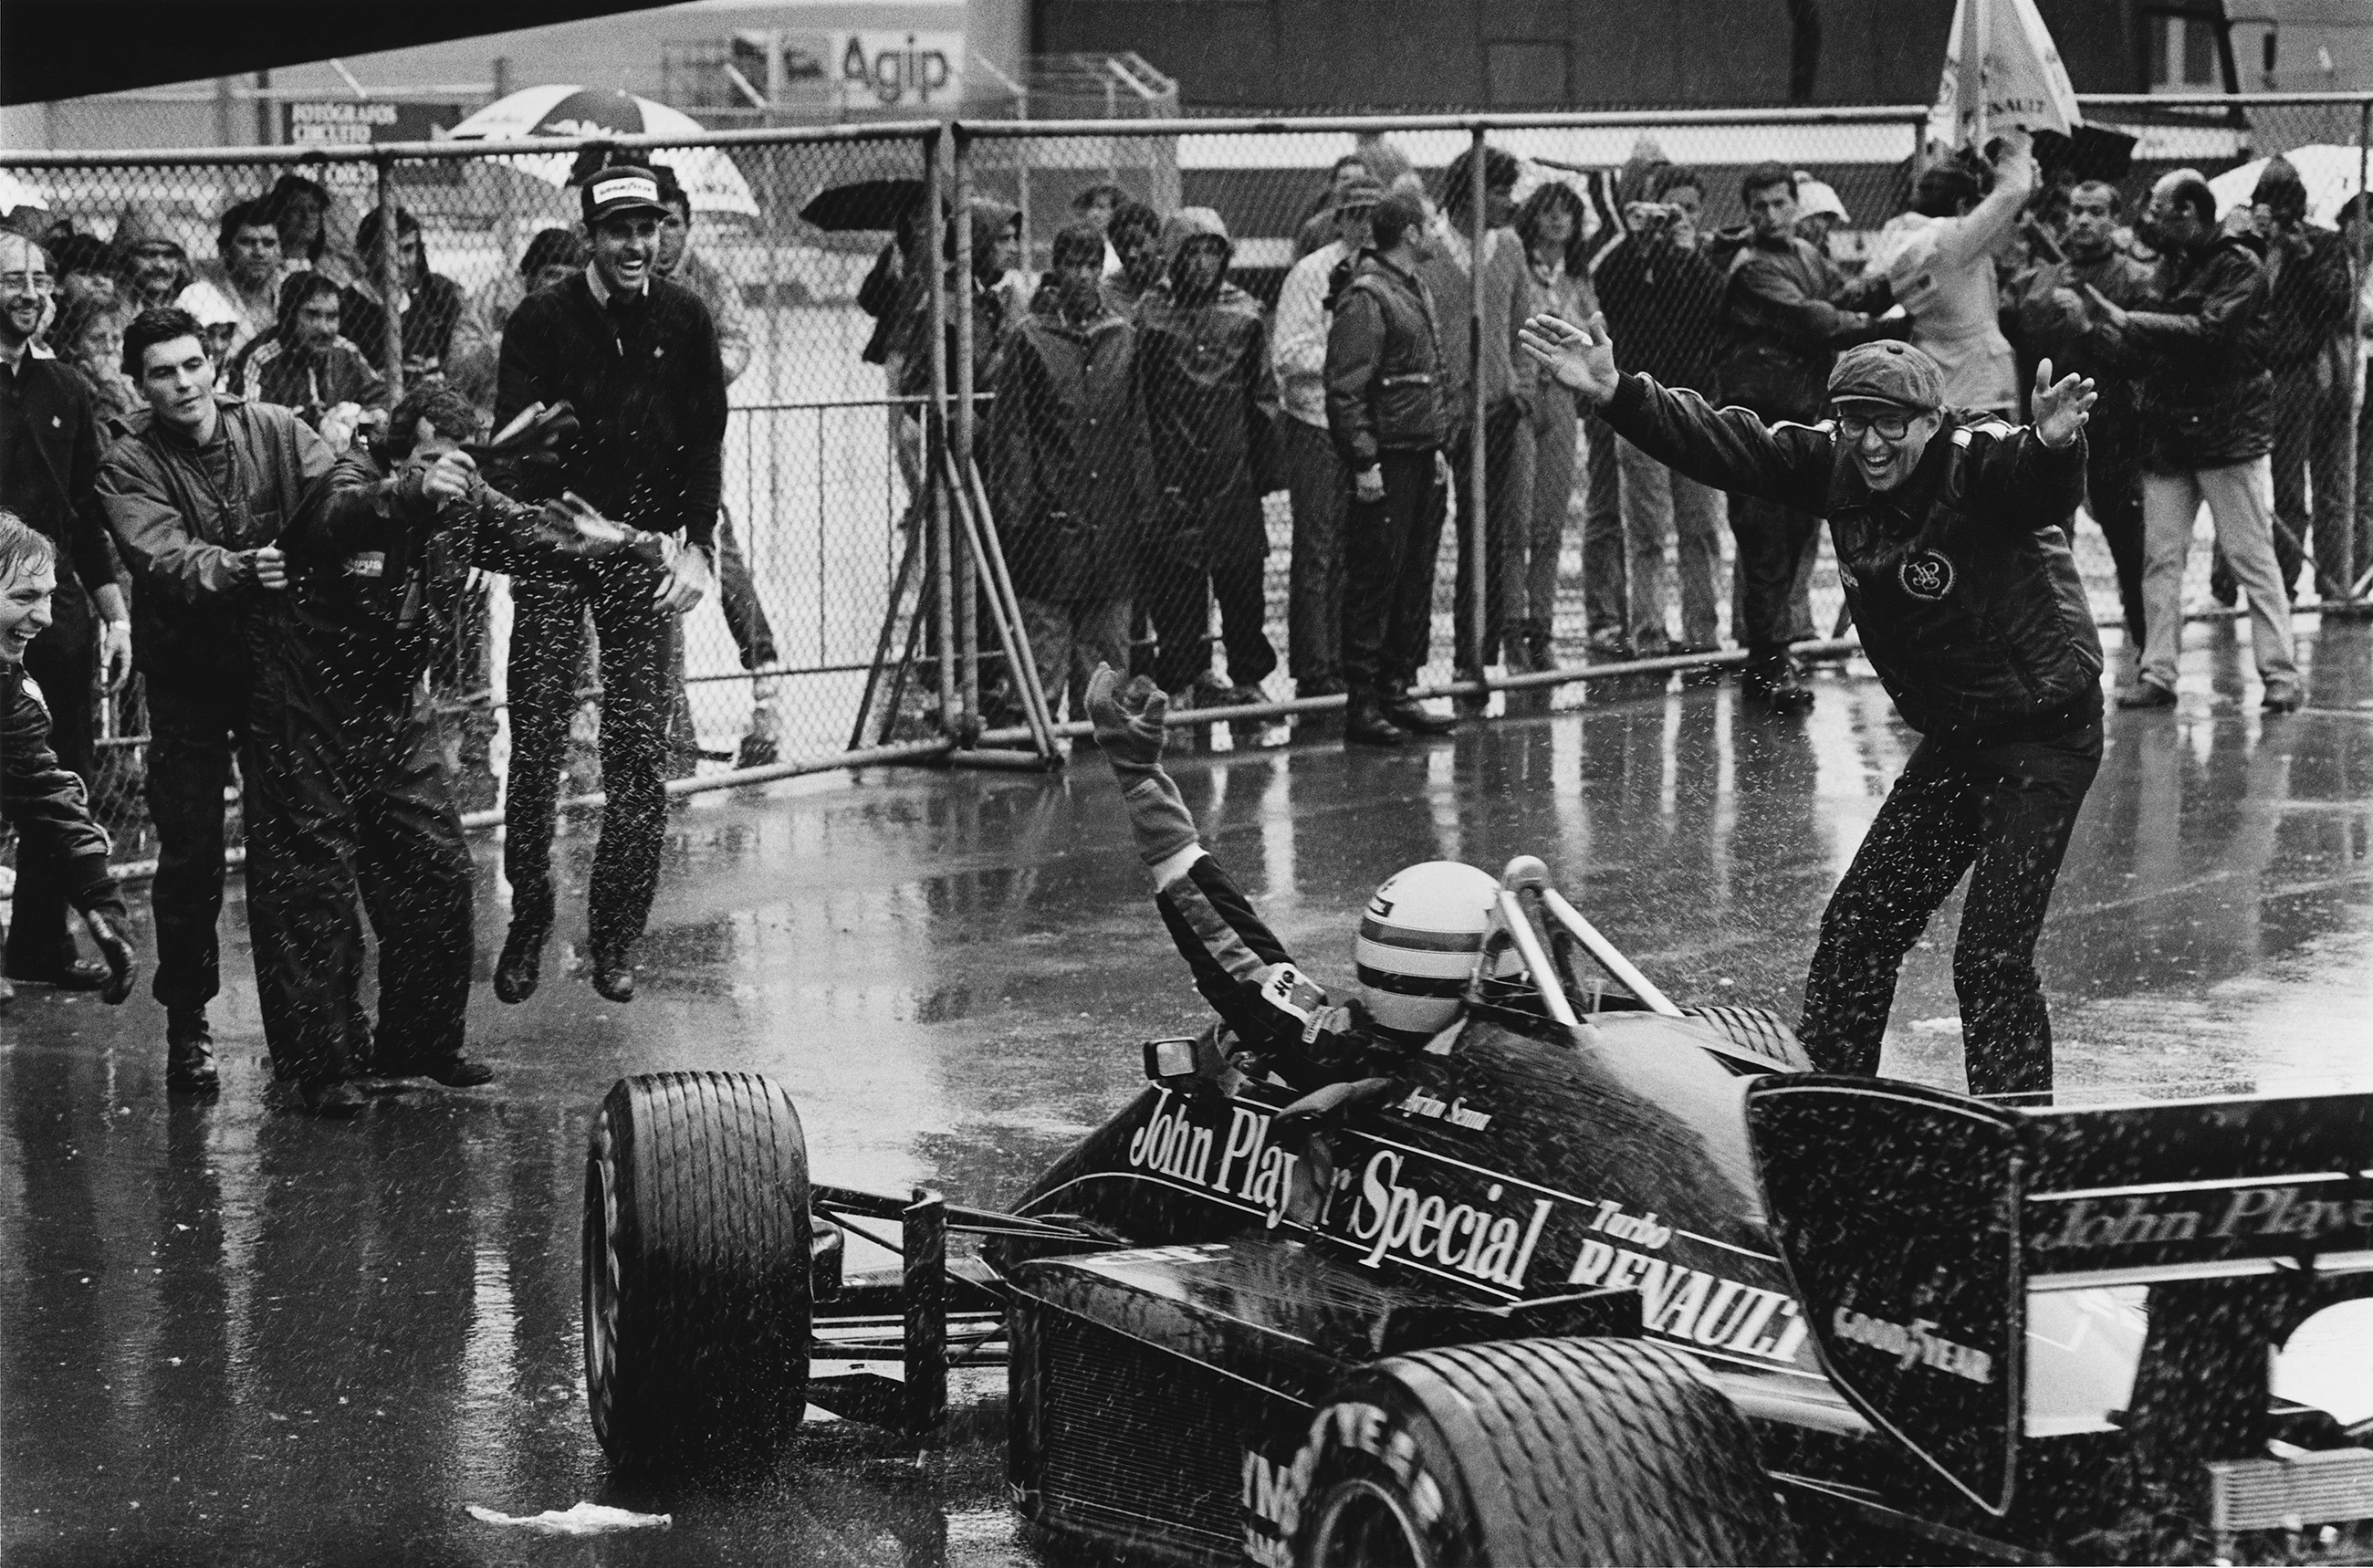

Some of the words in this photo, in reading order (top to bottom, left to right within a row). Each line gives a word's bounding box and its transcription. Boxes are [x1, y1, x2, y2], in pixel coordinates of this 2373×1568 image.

[842, 36, 951, 103] Agip
[1129, 1088, 1214, 1186] John
[1211, 1105, 1351, 1229] Playr
[1345, 1149, 1553, 1291] Special
[1588, 1198, 1672, 1249] Turbo
[2029, 1197, 2201, 1251] John
[1567, 1238, 1809, 1363] RENAULT
